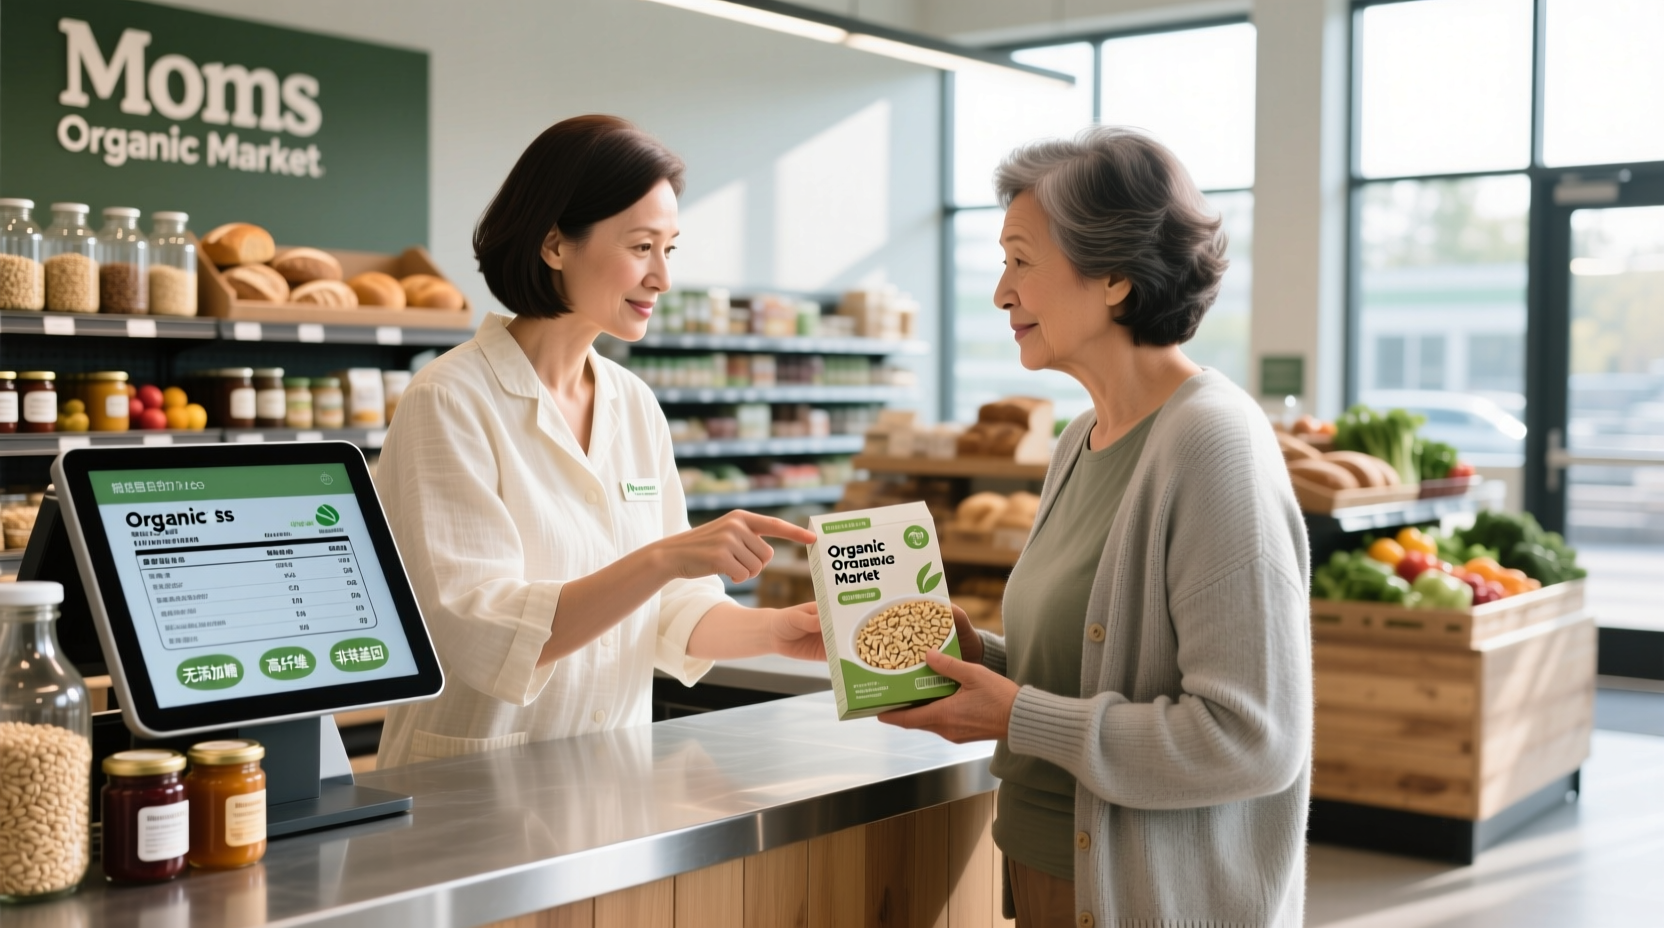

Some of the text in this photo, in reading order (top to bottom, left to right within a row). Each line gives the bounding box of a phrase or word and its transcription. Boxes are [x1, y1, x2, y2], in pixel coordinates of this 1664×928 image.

[58, 17, 322, 137] Moms
[57, 113, 323, 178] Organic Market
[125, 507, 207, 532] Organic
[827, 538, 886, 559] Organic
